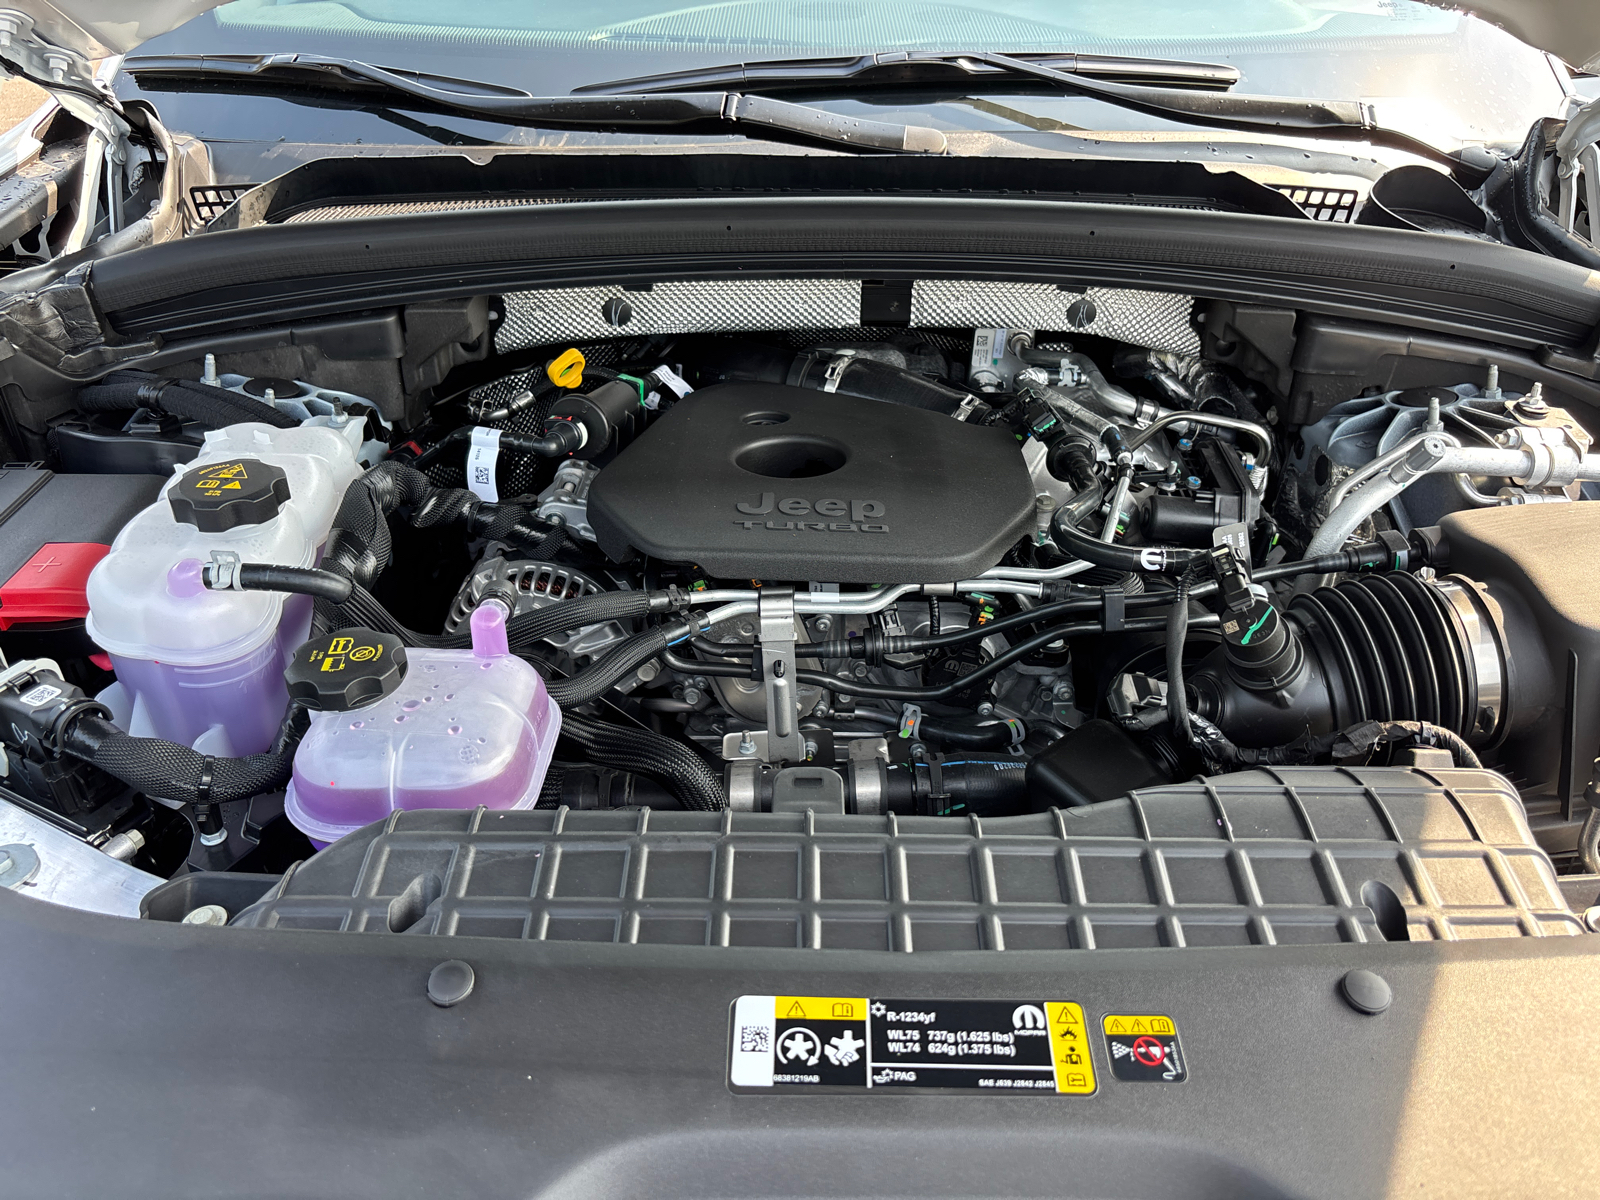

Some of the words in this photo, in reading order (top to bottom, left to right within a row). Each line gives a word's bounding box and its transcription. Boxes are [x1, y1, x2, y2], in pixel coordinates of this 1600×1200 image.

[736, 492, 886, 523] Jeep
[733, 520, 889, 533] TURBO
[886, 1011, 936, 1024] R-1234yf
[887, 1030, 920, 1040] WL75
[927, 1030, 953, 1043] 737g
[957, 1031, 990, 1043] (1.625
[992, 1032, 1014, 1044] lbs)
[887, 1042, 921, 1053] WL74
[928, 1043, 956, 1055] 624g
[958, 1043, 991, 1055] (1.375
[993, 1044, 1016, 1057] lbs)
[773, 1074, 820, 1083] 68381219AB
[894, 1072, 917, 1082] PAG
[978, 1079, 994, 1087] SAE
